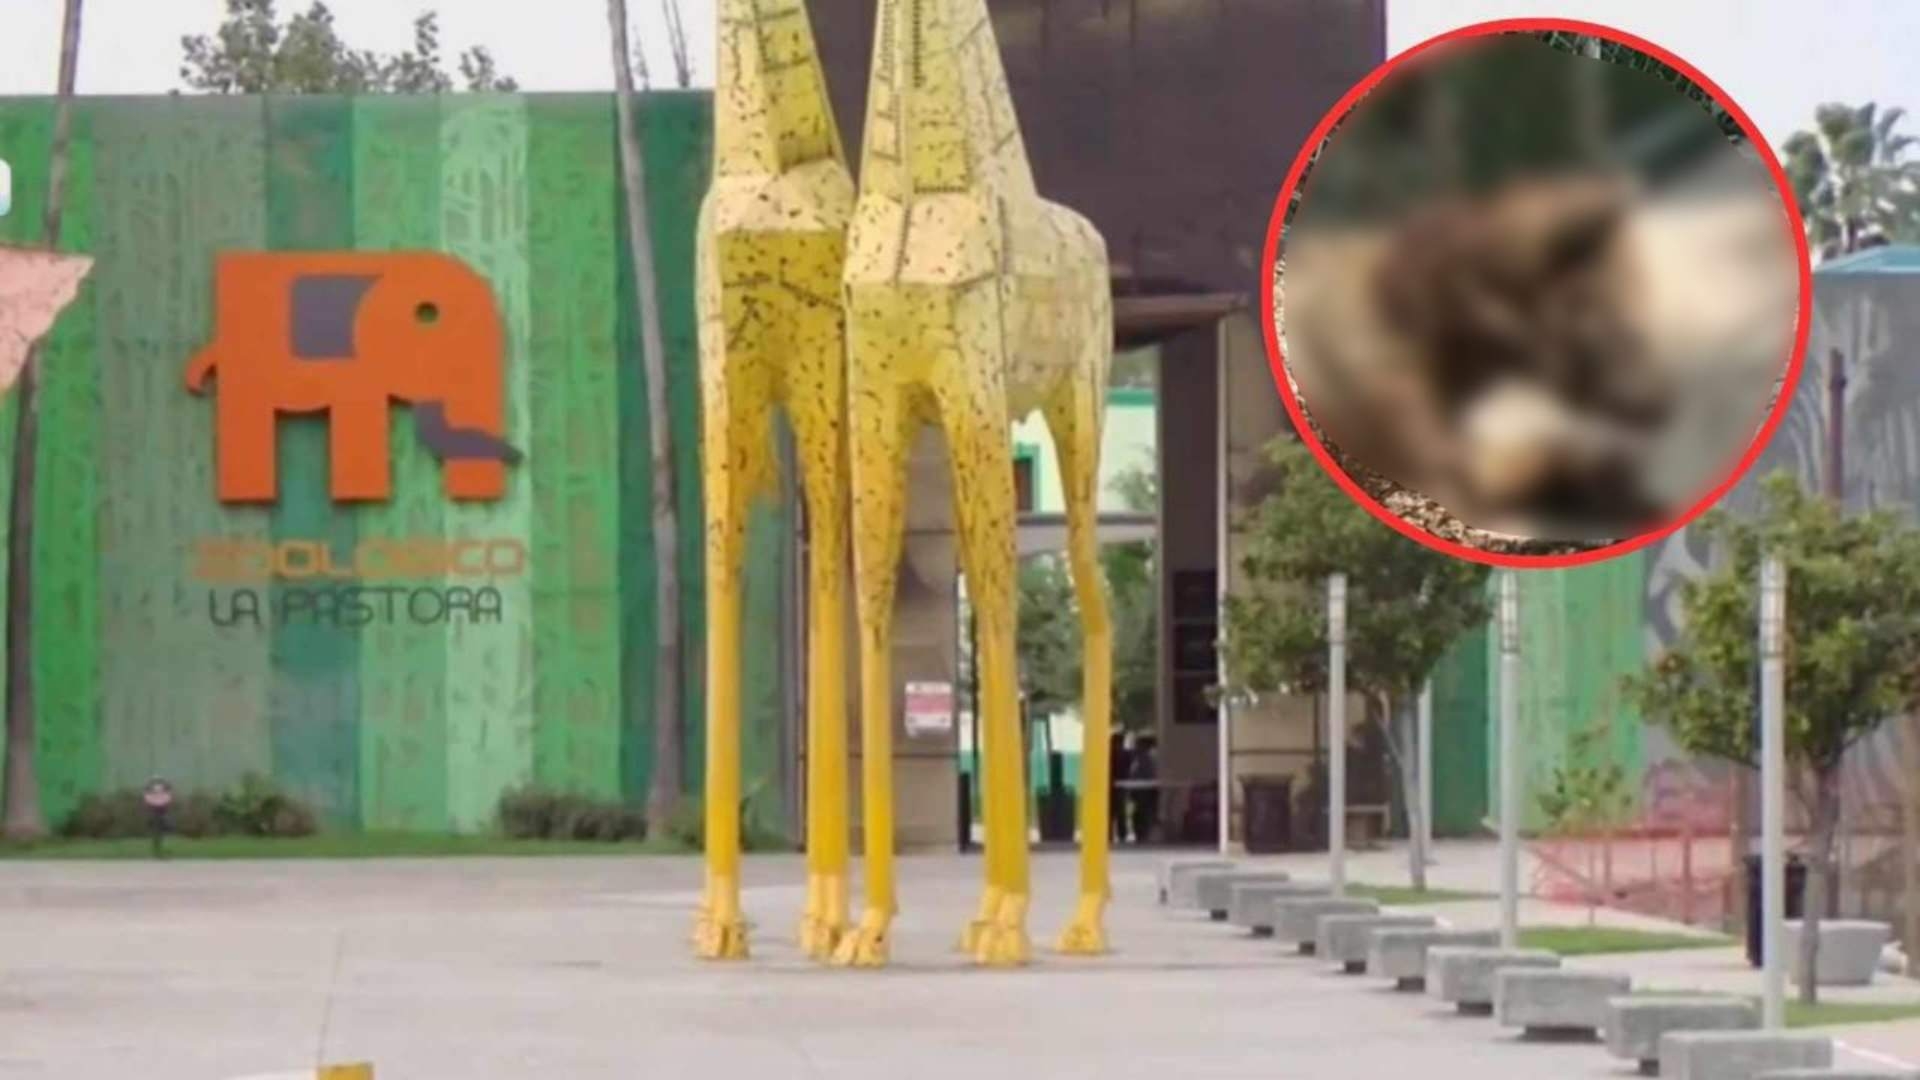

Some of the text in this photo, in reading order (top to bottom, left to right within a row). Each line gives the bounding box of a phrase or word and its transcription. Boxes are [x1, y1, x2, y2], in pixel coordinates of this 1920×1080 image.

[192, 538, 525, 578] OOLOCO
[208, 586, 502, 627] LA PASTORA
